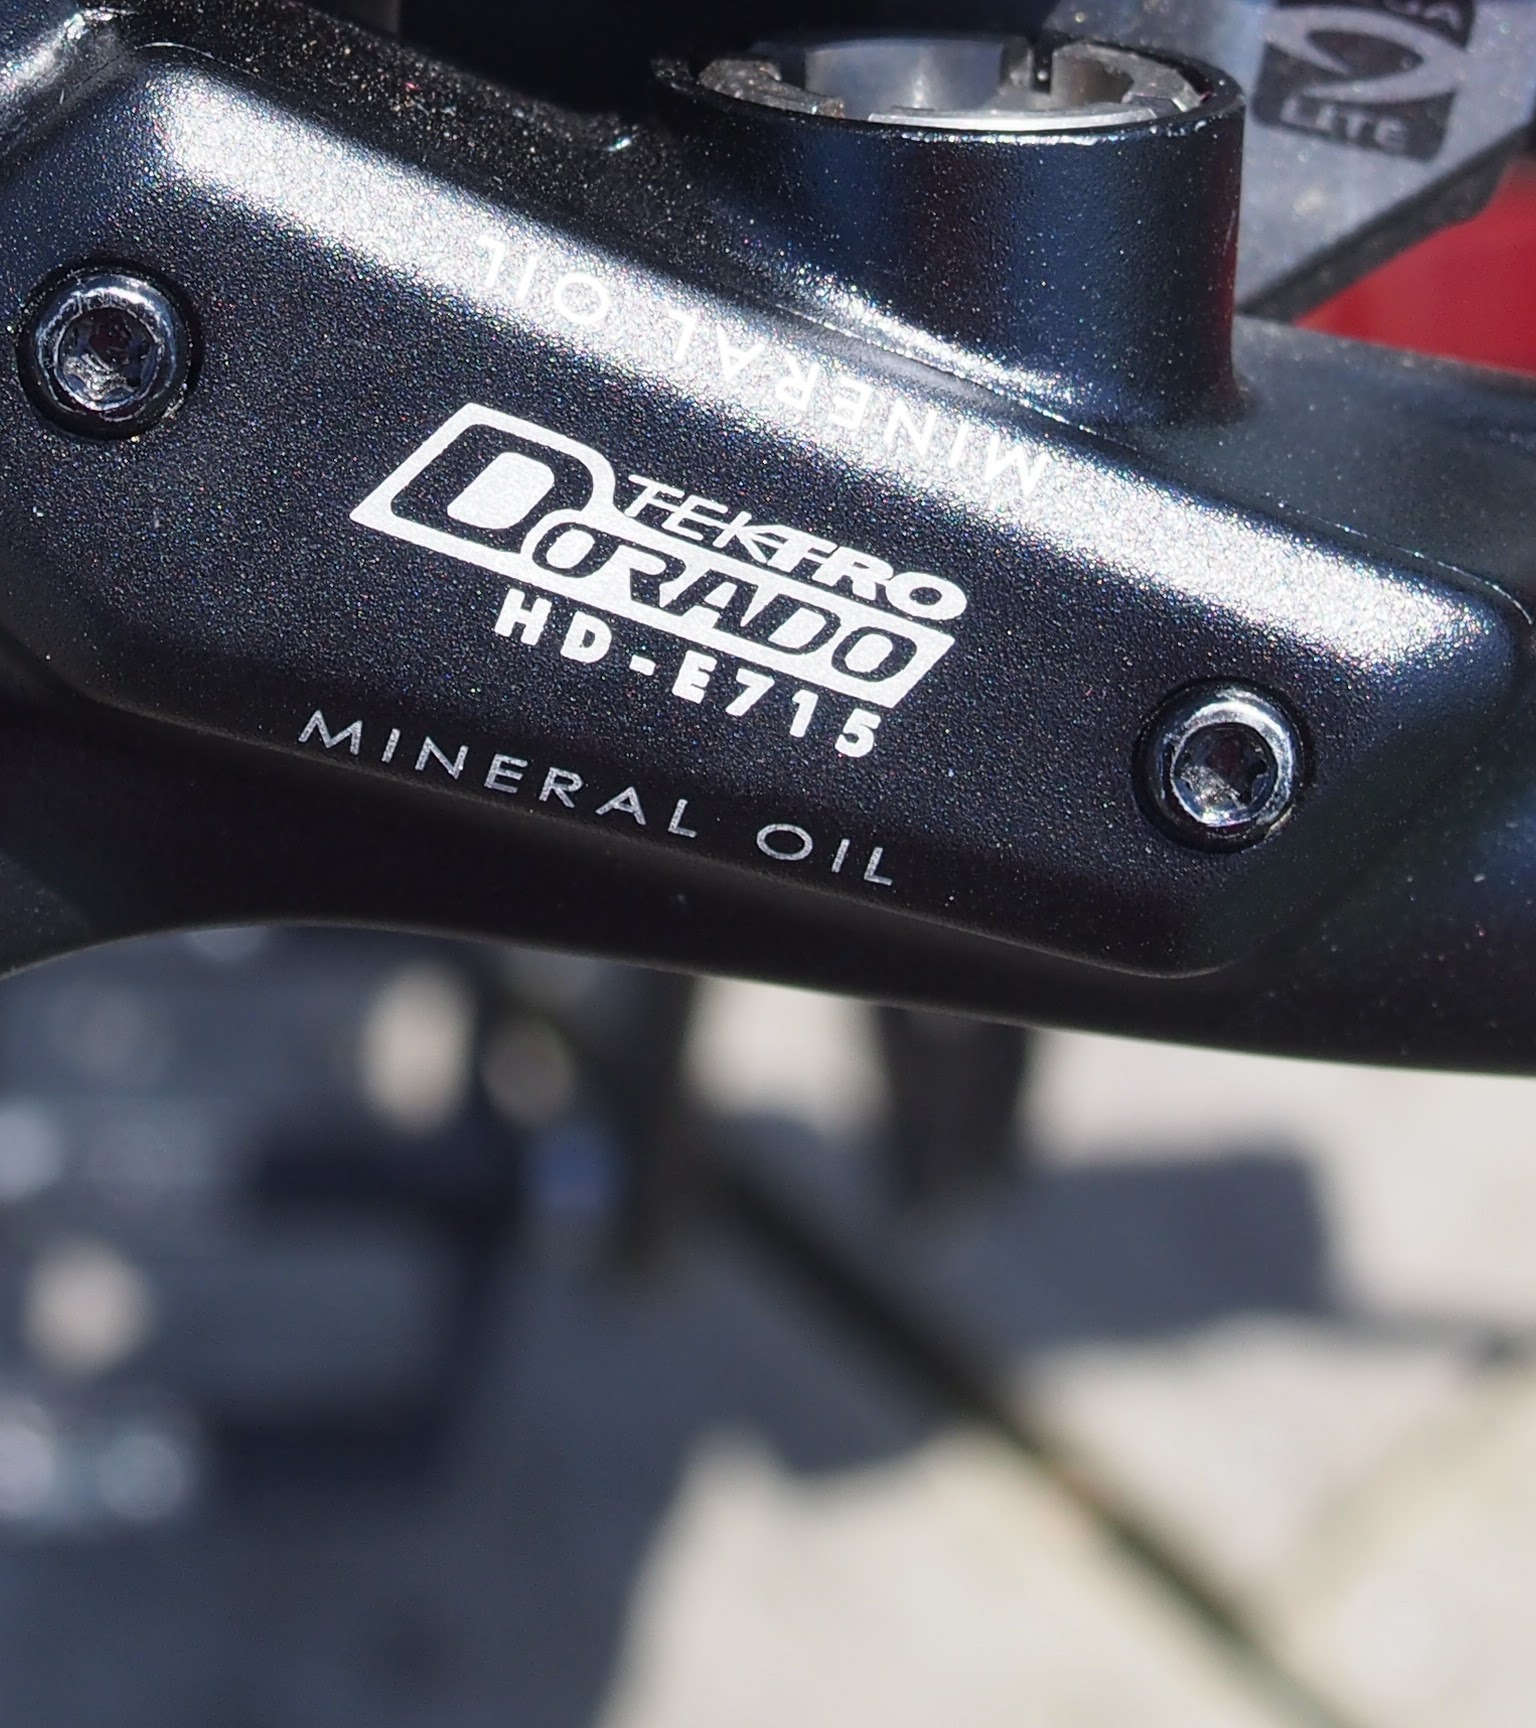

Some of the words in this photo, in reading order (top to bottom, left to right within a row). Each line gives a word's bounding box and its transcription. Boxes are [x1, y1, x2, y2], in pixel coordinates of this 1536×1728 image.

[1279, 94, 1408, 151] LITE
[473, 234, 612, 327] OIL
[663, 307, 1051, 498] MINERAL
[352, 403, 954, 708] DORADO
[623, 473, 968, 622] TEKTRO
[493, 587, 883, 758] HD-E715
[297, 708, 698, 839] MINERAL
[755, 822, 894, 888] OIL
